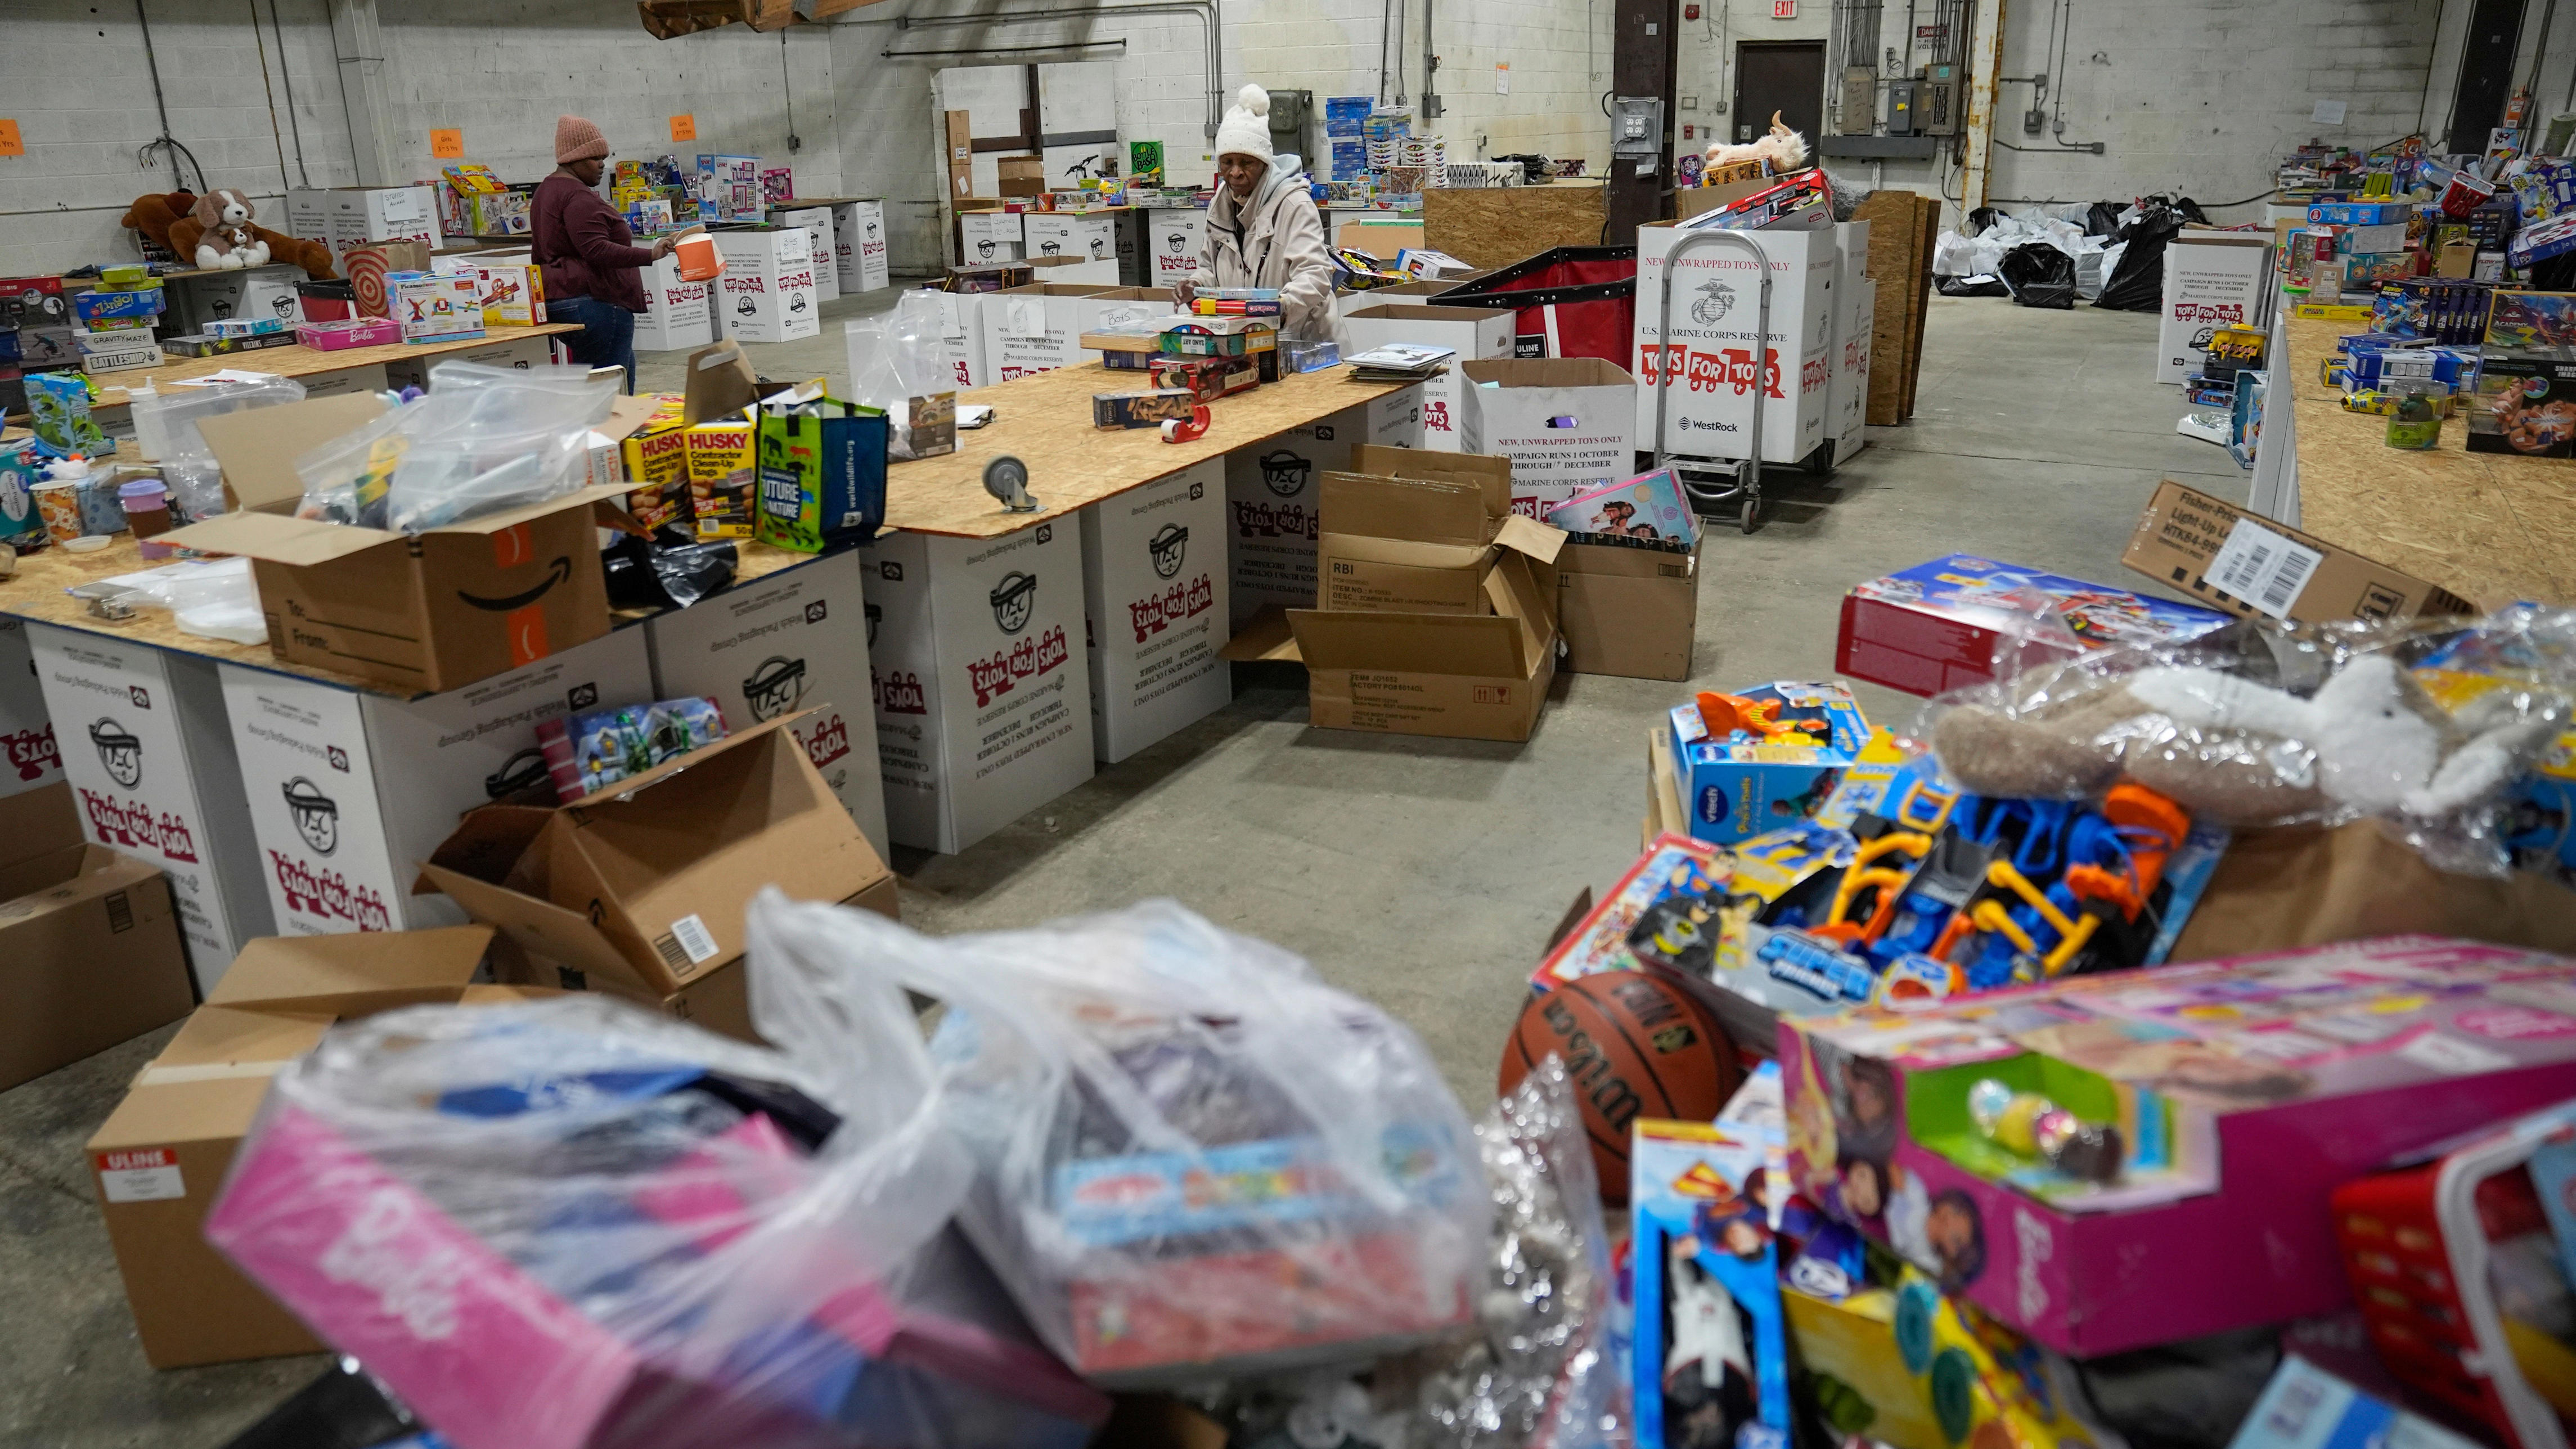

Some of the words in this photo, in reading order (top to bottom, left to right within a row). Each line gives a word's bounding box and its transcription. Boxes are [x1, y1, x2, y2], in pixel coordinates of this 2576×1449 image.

[1775, 1, 1794, 16] EXIT
[1132, 148, 1154, 161] BOTTLE
[1137, 156, 1156, 170] BASH
[783, 237, 798, 247] 3-5
[1672, 258, 1732, 269] UNWRAPPED
[1733, 260, 1759, 270] TOYS
[669, 292, 681, 300] TOTS
[693, 290, 703, 299] TOYS
[96, 294, 134, 314] Zingo!
[1248, 305, 1277, 313] OPERATION
[2176, 305, 2196, 316] TOYS
[2199, 309, 2215, 318] FOR
[2219, 310, 2241, 320] TOTS
[2493, 320, 2528, 328] ACADEMY
[93, 335, 125, 344] GRAVITY
[349, 330, 375, 343] Barbie
[1642, 327, 1659, 335] U.S.
[1703, 330, 1737, 340] CORPS
[1740, 332, 1787, 342] RESRVE
[1516, 343, 1539, 353] ULINE
[89, 352, 146, 369] BATTLESHIP
[1003, 368, 1021, 381] TOYS
[1690, 357, 1722, 380] FOR
[1732, 363, 1774, 387] TOS
[1693, 420, 1738, 433] WestRock
[641, 433, 684, 458] HUSKY
[689, 433, 748, 449] HUSKY
[1522, 438, 1576, 447] UNWRAPPED
[1577, 436, 1599, 445] TOYS
[1601, 435, 1624, 444] ONLY
[644, 451, 683, 468] Contractor
[1579, 450, 1619, 459] OCTOBER
[692, 460, 735, 468] Clean-Up
[1510, 461, 1553, 470] THROUGH
[1565, 460, 1611, 469] DECEMBER
[693, 468, 718, 478] Bags
[846, 439, 856, 509] worldwildlife.org
[1553, 478, 1579, 487] CORPS
[1174, 492, 1189, 503] Welch
[2179, 492, 2238, 523] Fisher-Pric
[1241, 510, 1272, 526] TOTS
[1280, 513, 1303, 532] FOR
[2171, 507, 2217, 534] Light-Up
[1239, 543, 1270, 553] RESERVE
[1244, 560, 1285, 570] DECEMBER
[1333, 562, 1354, 575] RBI
[1237, 568, 1273, 578] OCTOBER
[1235, 580, 1253, 589] ONLY
[1255, 582, 1274, 591] TOYS
[1166, 597, 1185, 614] FOR
[1188, 586, 1210, 610] TOYS
[1136, 606, 1162, 628] TOTS
[1162, 634, 1180, 648] CORPS
[1039, 639, 1066, 667] TOYS
[1136, 643, 1161, 660] RESERVE
[1013, 652, 1034, 672] FOR
[1139, 656, 1173, 677] DECEMBER
[976, 667, 1008, 691] TOTS
[1134, 673, 1163, 691] OCTOBER
[886, 687, 923, 708] TOYS
[1134, 694, 1150, 708] ONLY
[1150, 688, 1165, 700] TOYS
[811, 731, 846, 763] TOYS
[1706, 787, 1719, 824] vtech
[92, 802, 125, 831] TOTS
[131, 816, 155, 842] FOR
[163, 827, 195, 857] TOYS
[1757, 932, 1873, 1002] SUPER
[1543, 997, 1643, 1136] Wilson
[107, 1150, 164, 1170] ULINE
